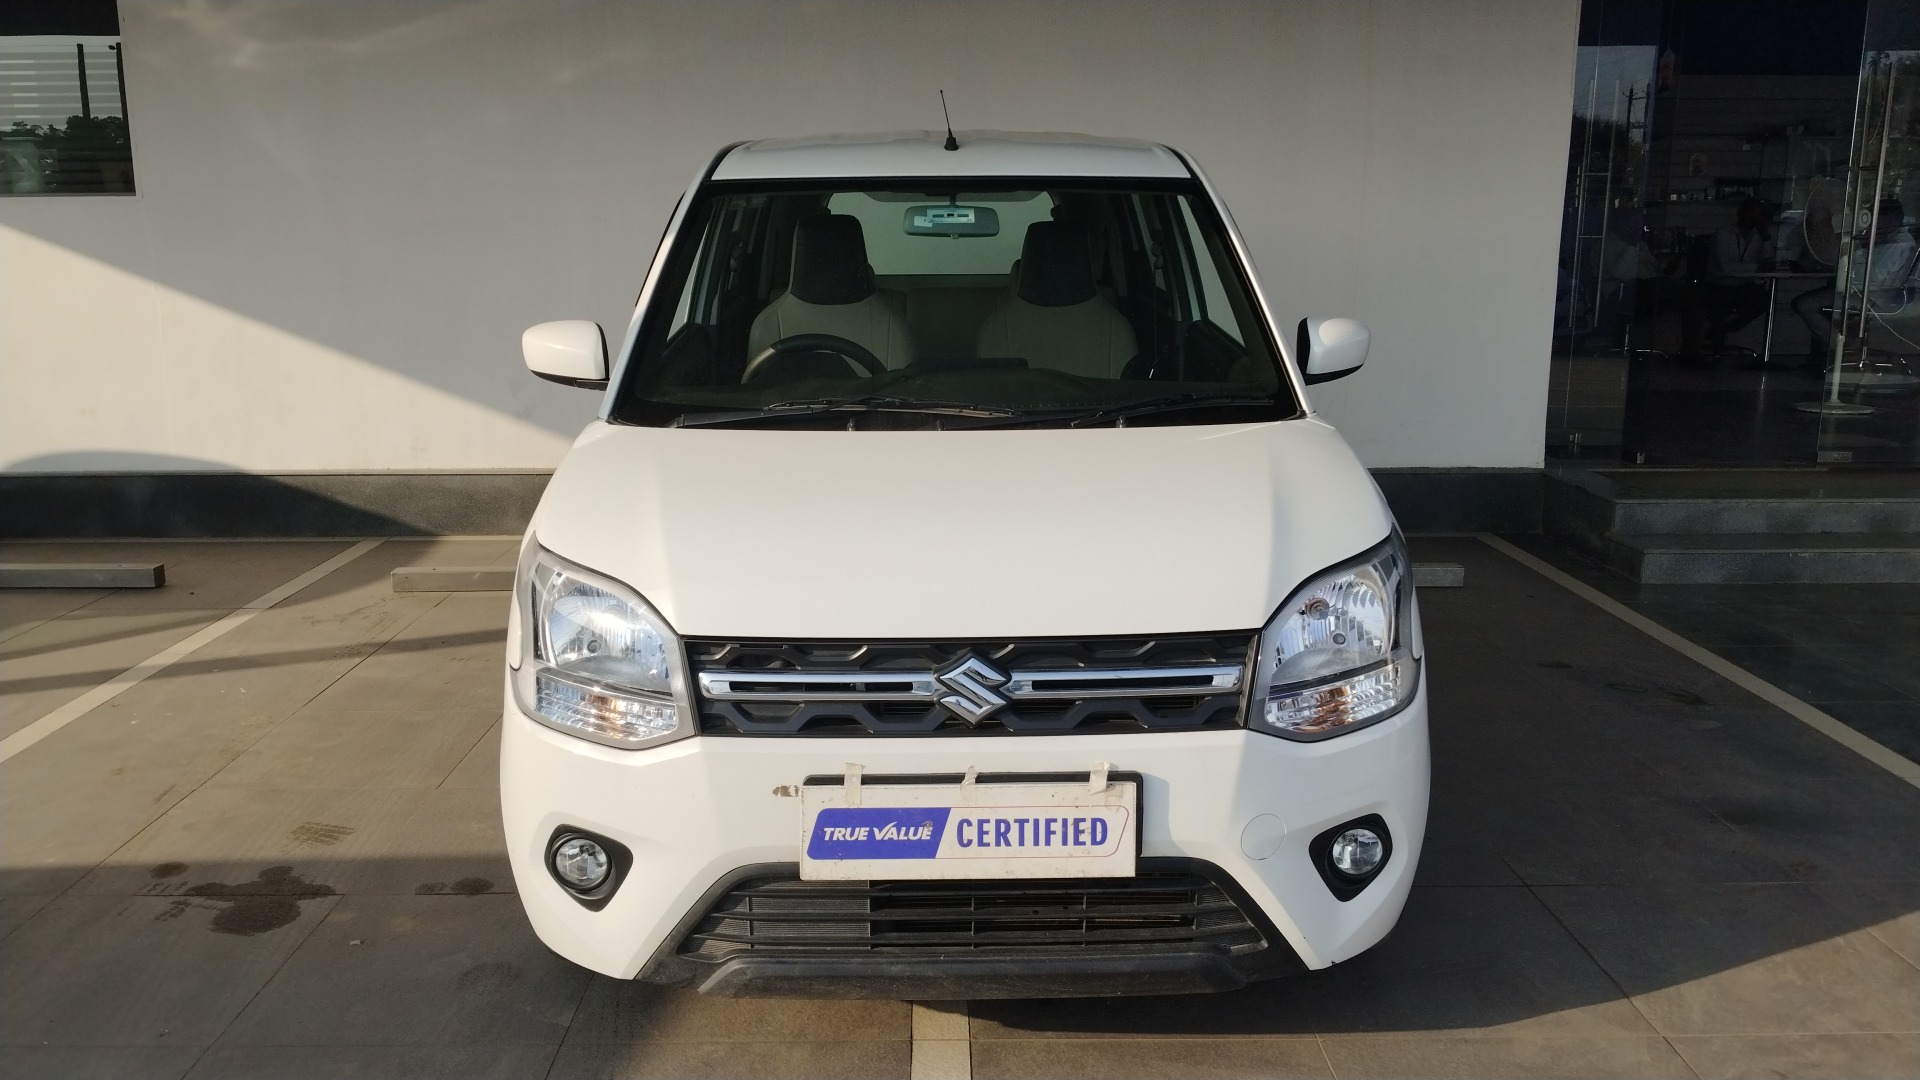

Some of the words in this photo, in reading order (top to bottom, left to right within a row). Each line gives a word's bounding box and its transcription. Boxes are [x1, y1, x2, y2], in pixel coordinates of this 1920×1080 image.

[823, 827, 868, 841] TRUE
[873, 821, 933, 841] VALUE
[956, 817, 1109, 848] CERTIFIED
